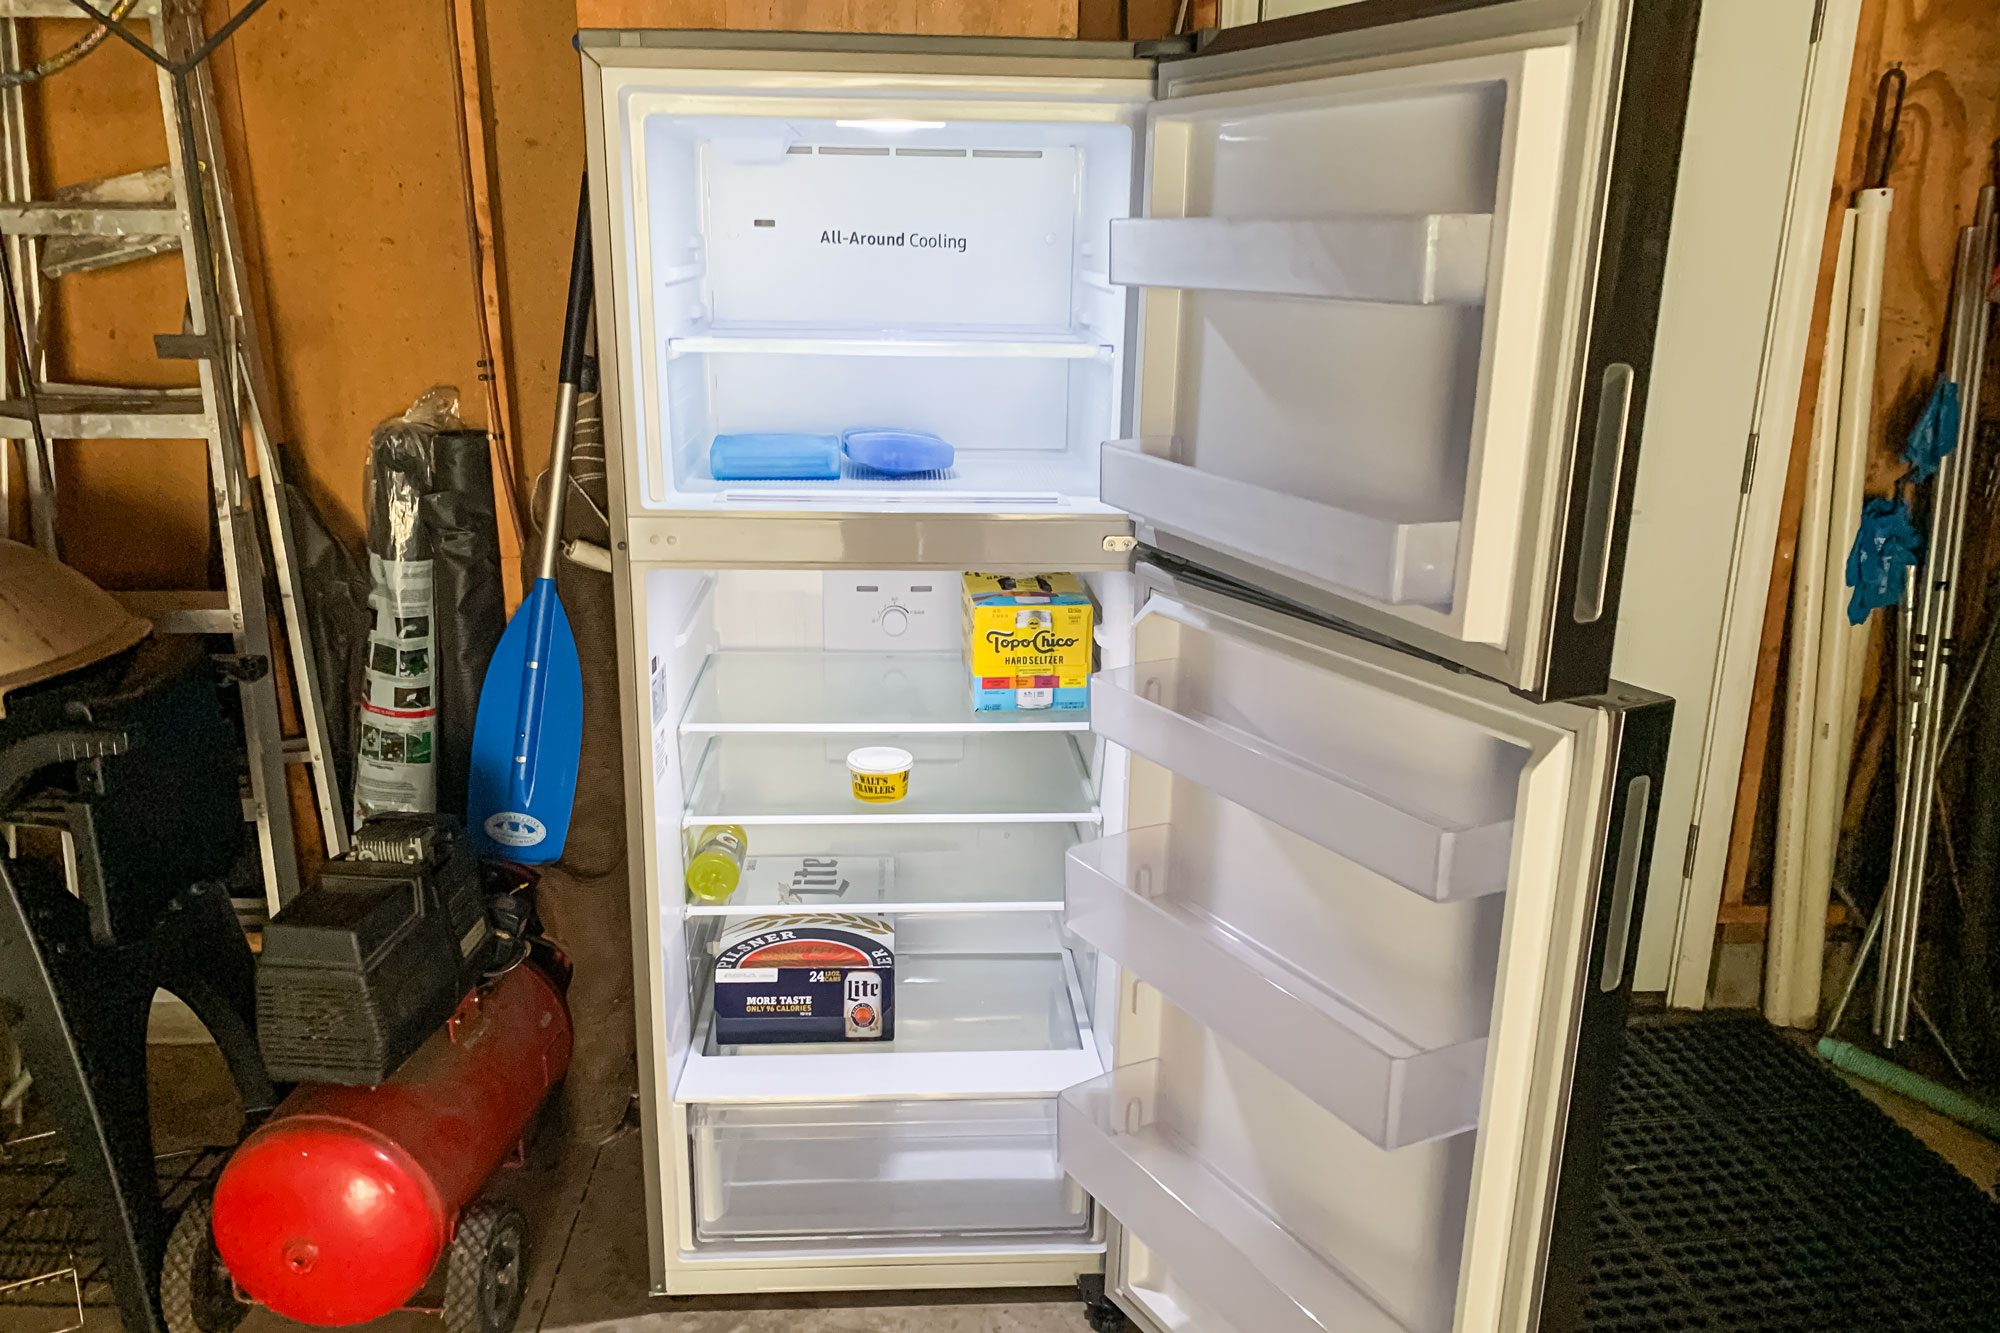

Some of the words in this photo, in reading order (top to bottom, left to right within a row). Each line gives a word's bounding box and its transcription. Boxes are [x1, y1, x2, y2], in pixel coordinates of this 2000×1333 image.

[820, 230, 905, 247] All-Around
[909, 233, 967, 253] Cooling
[986, 630, 1033, 654] Topo
[1032, 630, 1080, 654] Chico
[1004, 656, 1028, 665] HARD
[1029, 655, 1065, 665] SELTZER
[860, 775, 889, 786] WALT'S
[788, 858, 850, 898] Lite
[716, 930, 797, 969] PILSNER
[871, 948, 893, 969] ER
[808, 970, 825, 983] 24
[746, 996, 777, 1005] MORE
[779, 996, 812, 1005] TASTE
[847, 980, 879, 1002] Lite
[746, 1005, 766, 1013] ONLY
[776, 1004, 812, 1012] CALORIES
